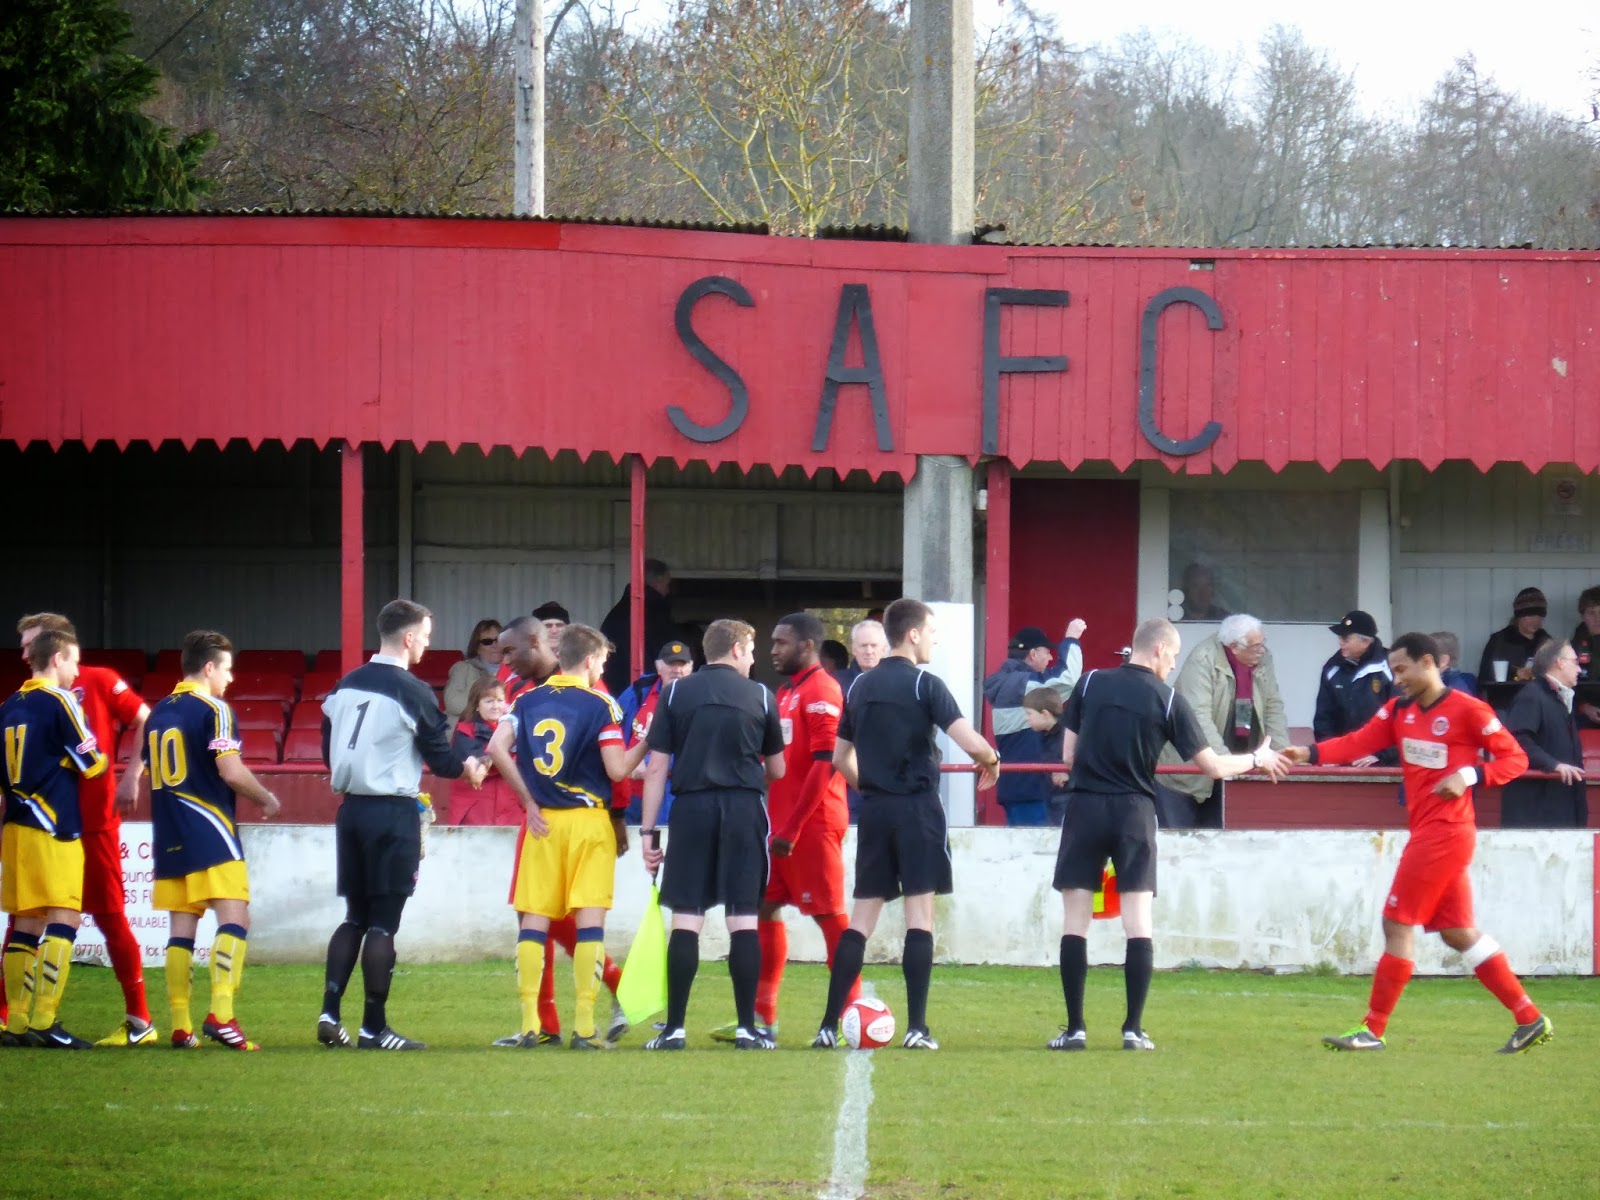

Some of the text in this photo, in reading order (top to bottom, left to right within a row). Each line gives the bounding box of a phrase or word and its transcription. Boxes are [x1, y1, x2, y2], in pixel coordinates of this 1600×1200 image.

[347, 700, 371, 750] 1
[533, 718, 566, 778] 3
[149, 728, 187, 790] 10
[119, 842, 129, 859] &
